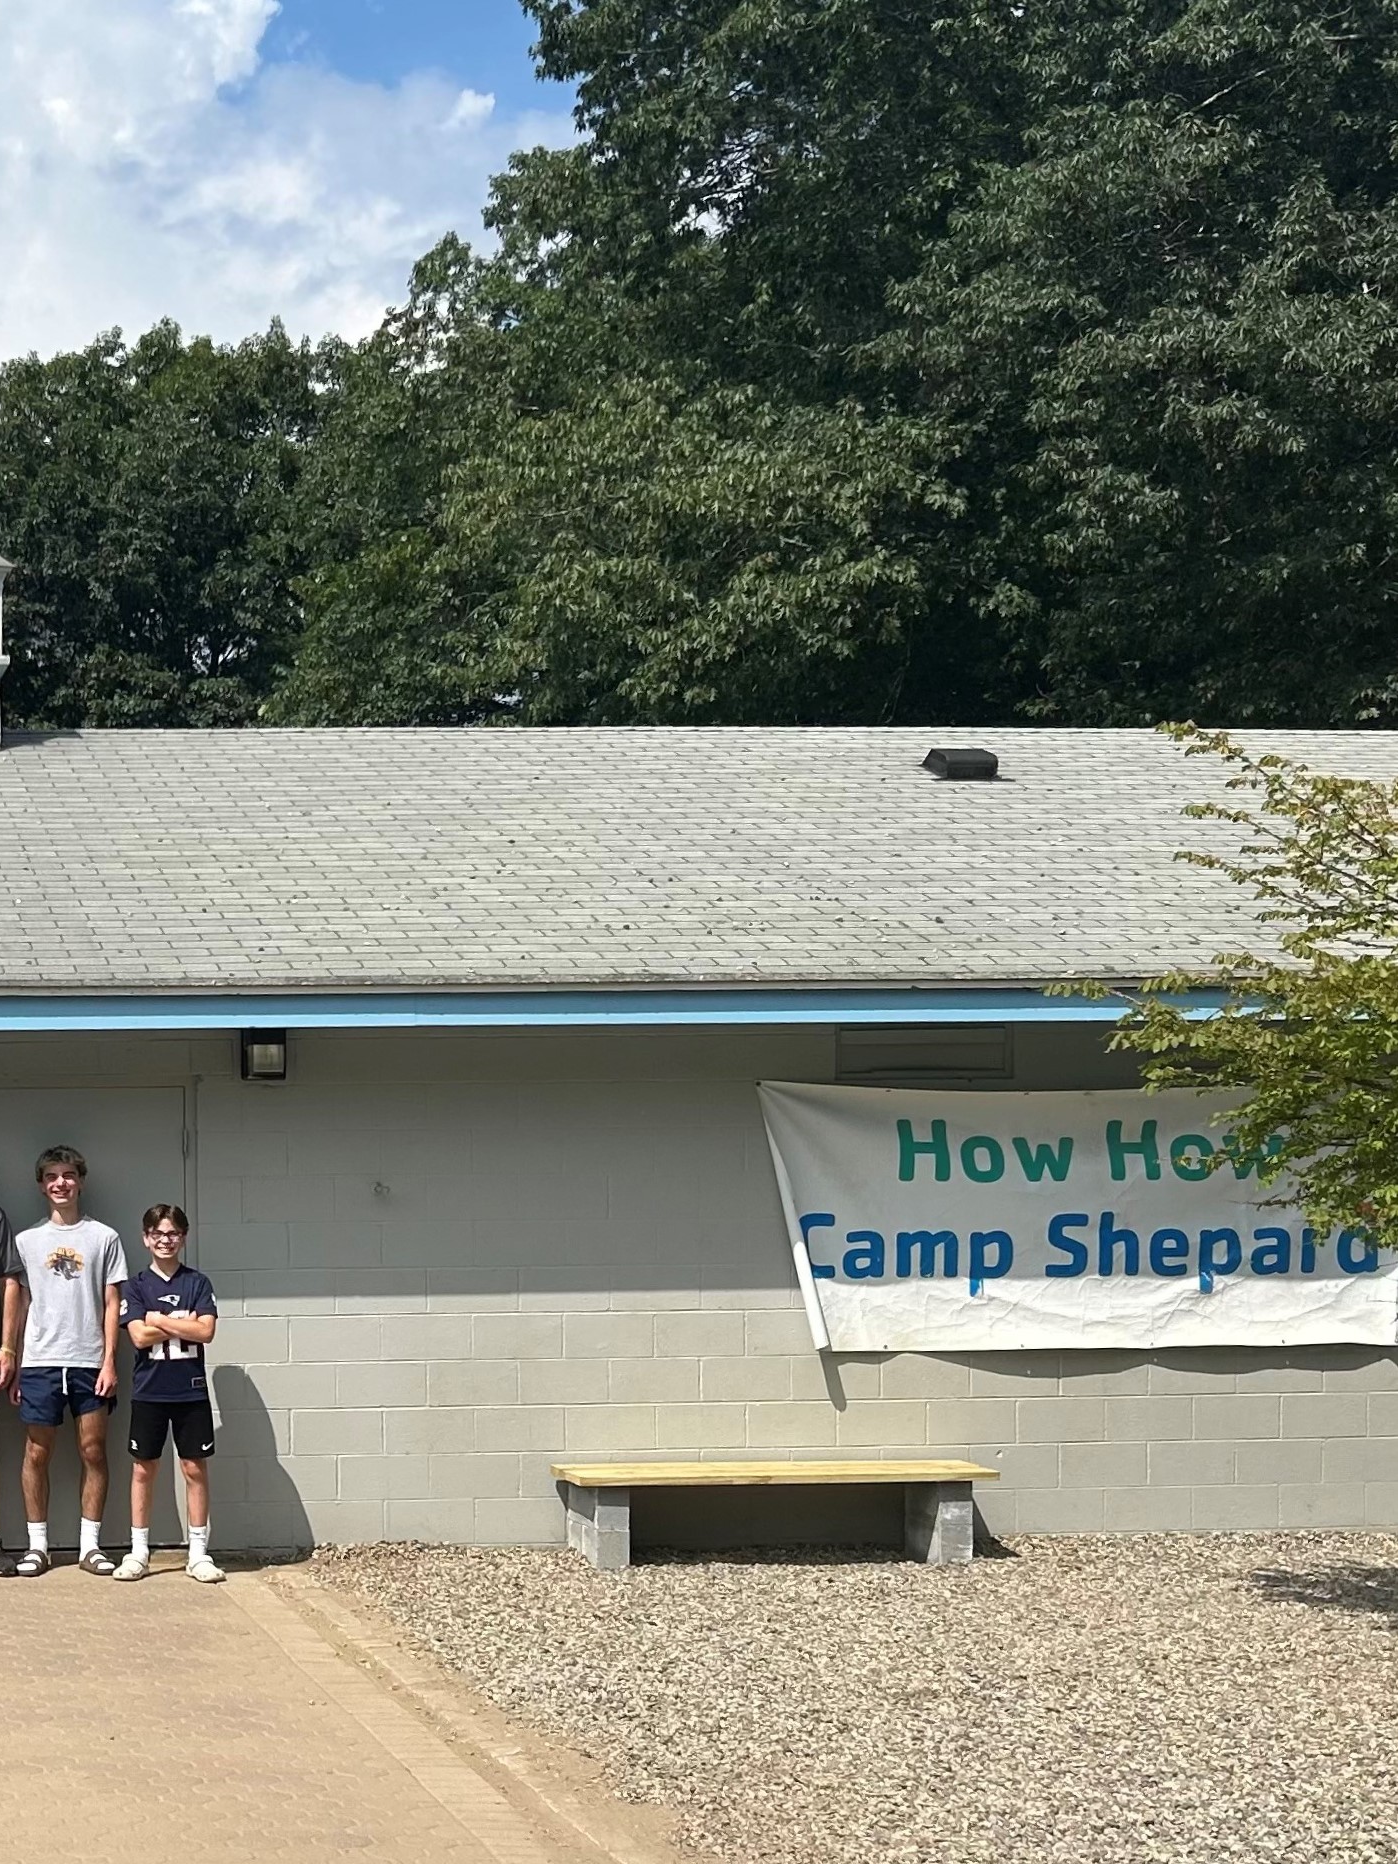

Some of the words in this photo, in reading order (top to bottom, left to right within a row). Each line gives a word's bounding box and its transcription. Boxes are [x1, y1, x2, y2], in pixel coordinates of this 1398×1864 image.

[896, 1118, 1074, 1183] How
[1105, 1119, 1288, 1182] How
[798, 1212, 1014, 1298] Camp
